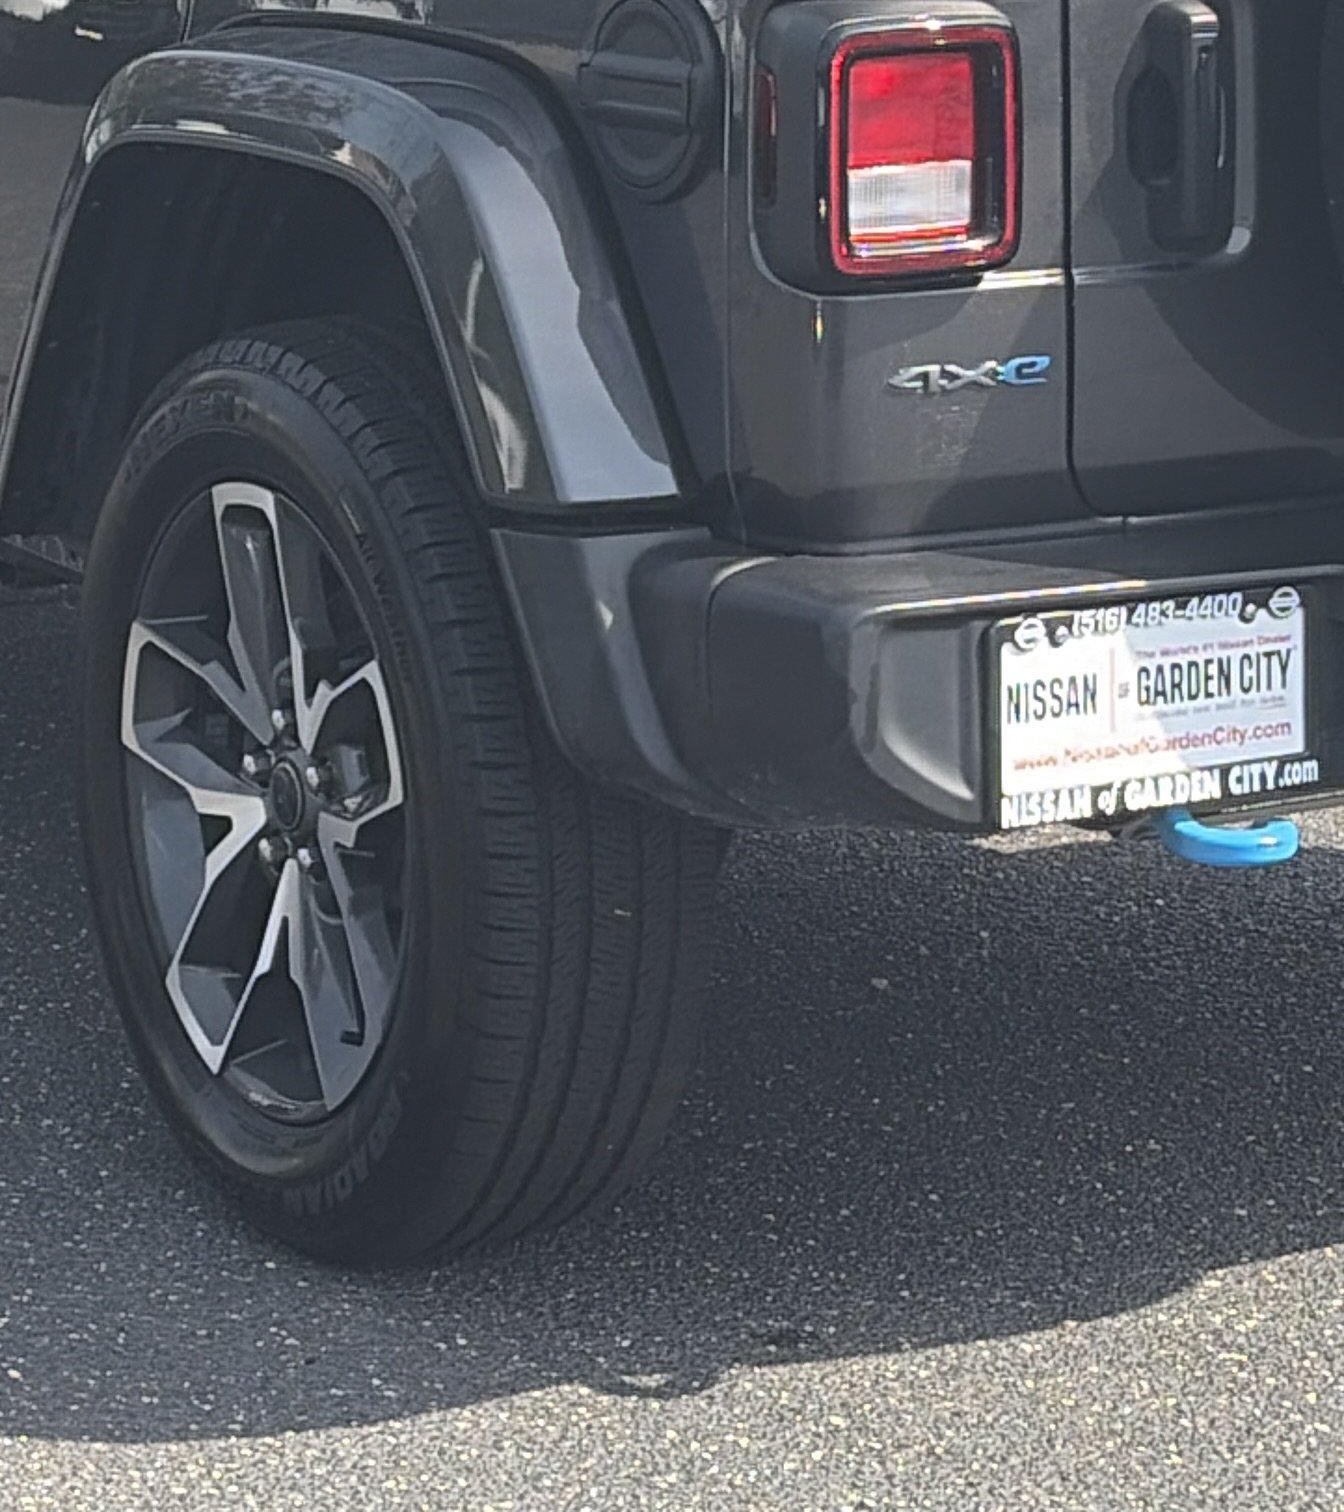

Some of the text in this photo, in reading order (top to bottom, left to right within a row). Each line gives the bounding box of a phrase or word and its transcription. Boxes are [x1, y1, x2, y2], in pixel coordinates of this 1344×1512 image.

[1131, 592, 1243, 629] 483-4400
[1006, 672, 1098, 725] NISSAN
[1137, 654, 1232, 707] GARDEN
[1239, 648, 1292, 695] CITY
[1001, 786, 1093, 830] NISSAN
[1098, 780, 1121, 816] of
[1124, 768, 1222, 812] GARDEN
